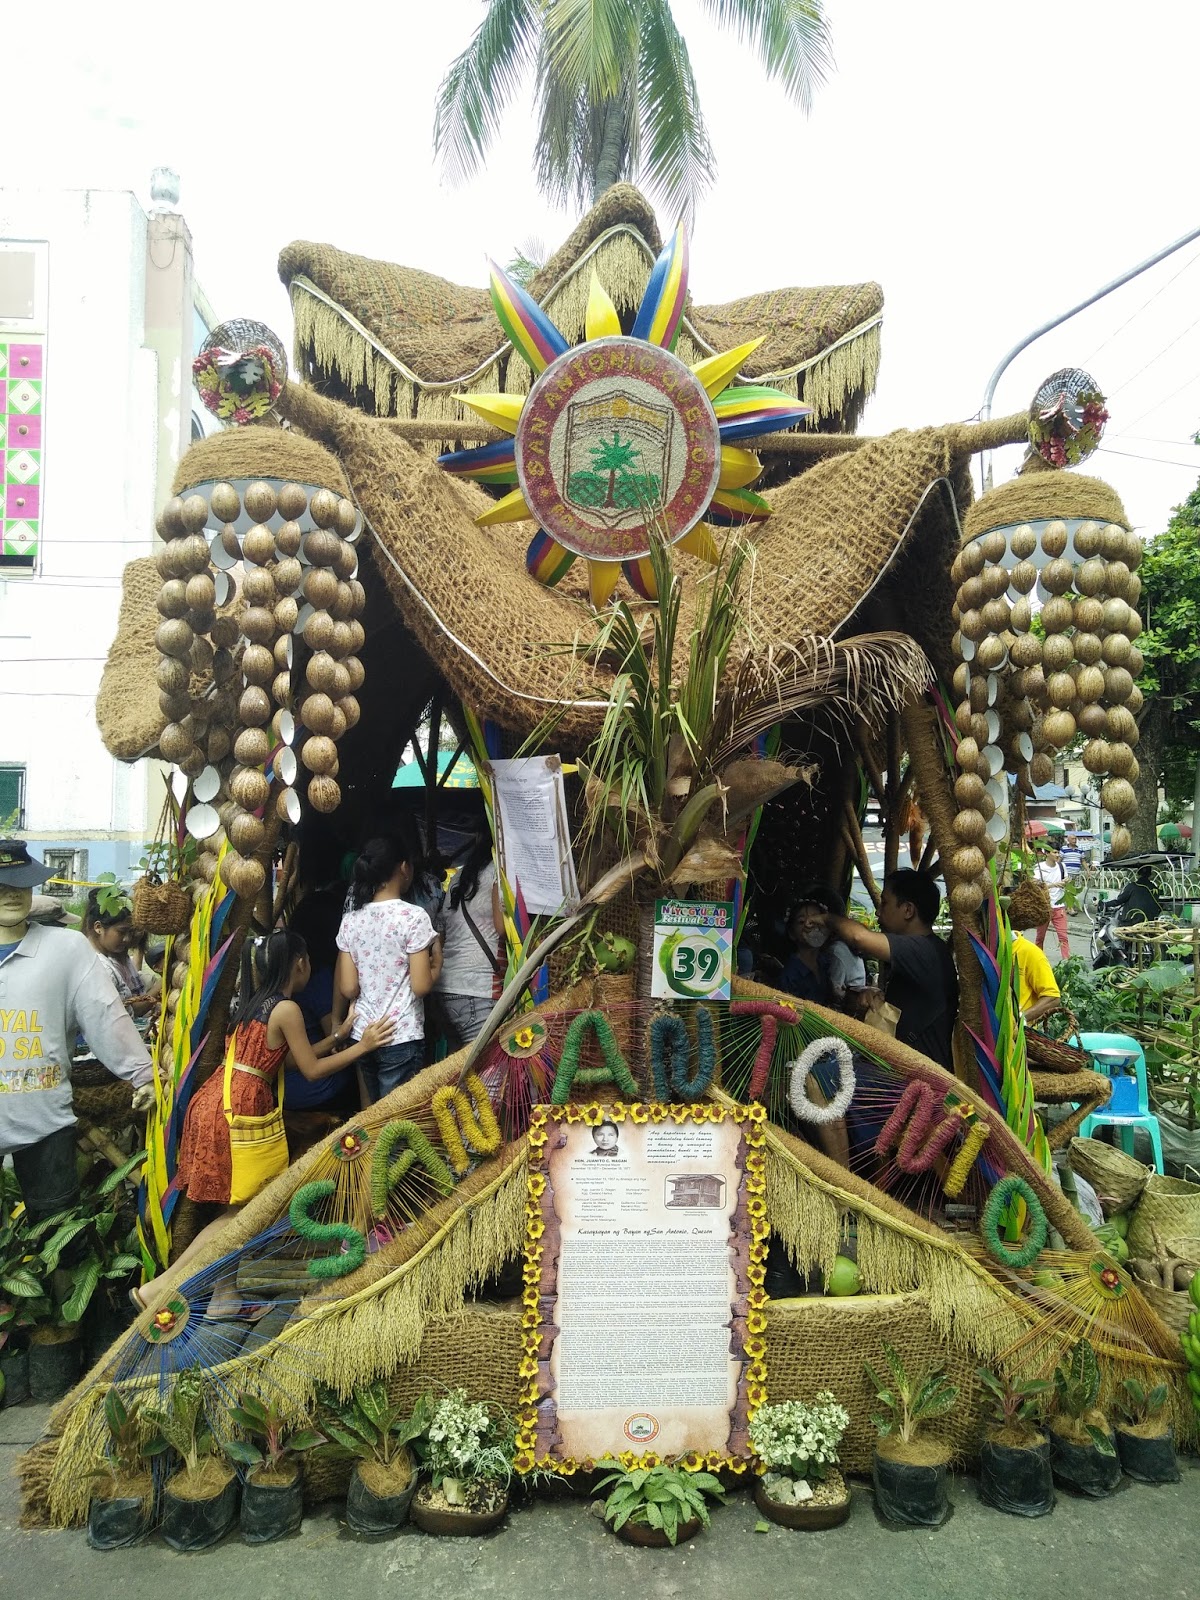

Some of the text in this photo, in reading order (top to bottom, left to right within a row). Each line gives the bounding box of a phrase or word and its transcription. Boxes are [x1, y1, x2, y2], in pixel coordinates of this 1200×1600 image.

[527, 351, 708, 486] SAN ANTONIO QUEZON
[662, 913, 727, 927] Festival 2016
[674, 946, 720, 981] 39
[12, 1036, 44, 1060] SA
[289, 1000, 1048, 1279] SAN ANTONIO
[577, 1227, 611, 1237] Kasaysayan
[613, 1229, 620, 1237] ng
[622, 1227, 642, 1237] Bayan
[664, 1227, 689, 1236] Antonio,
[691, 1227, 713, 1236] Quezon
